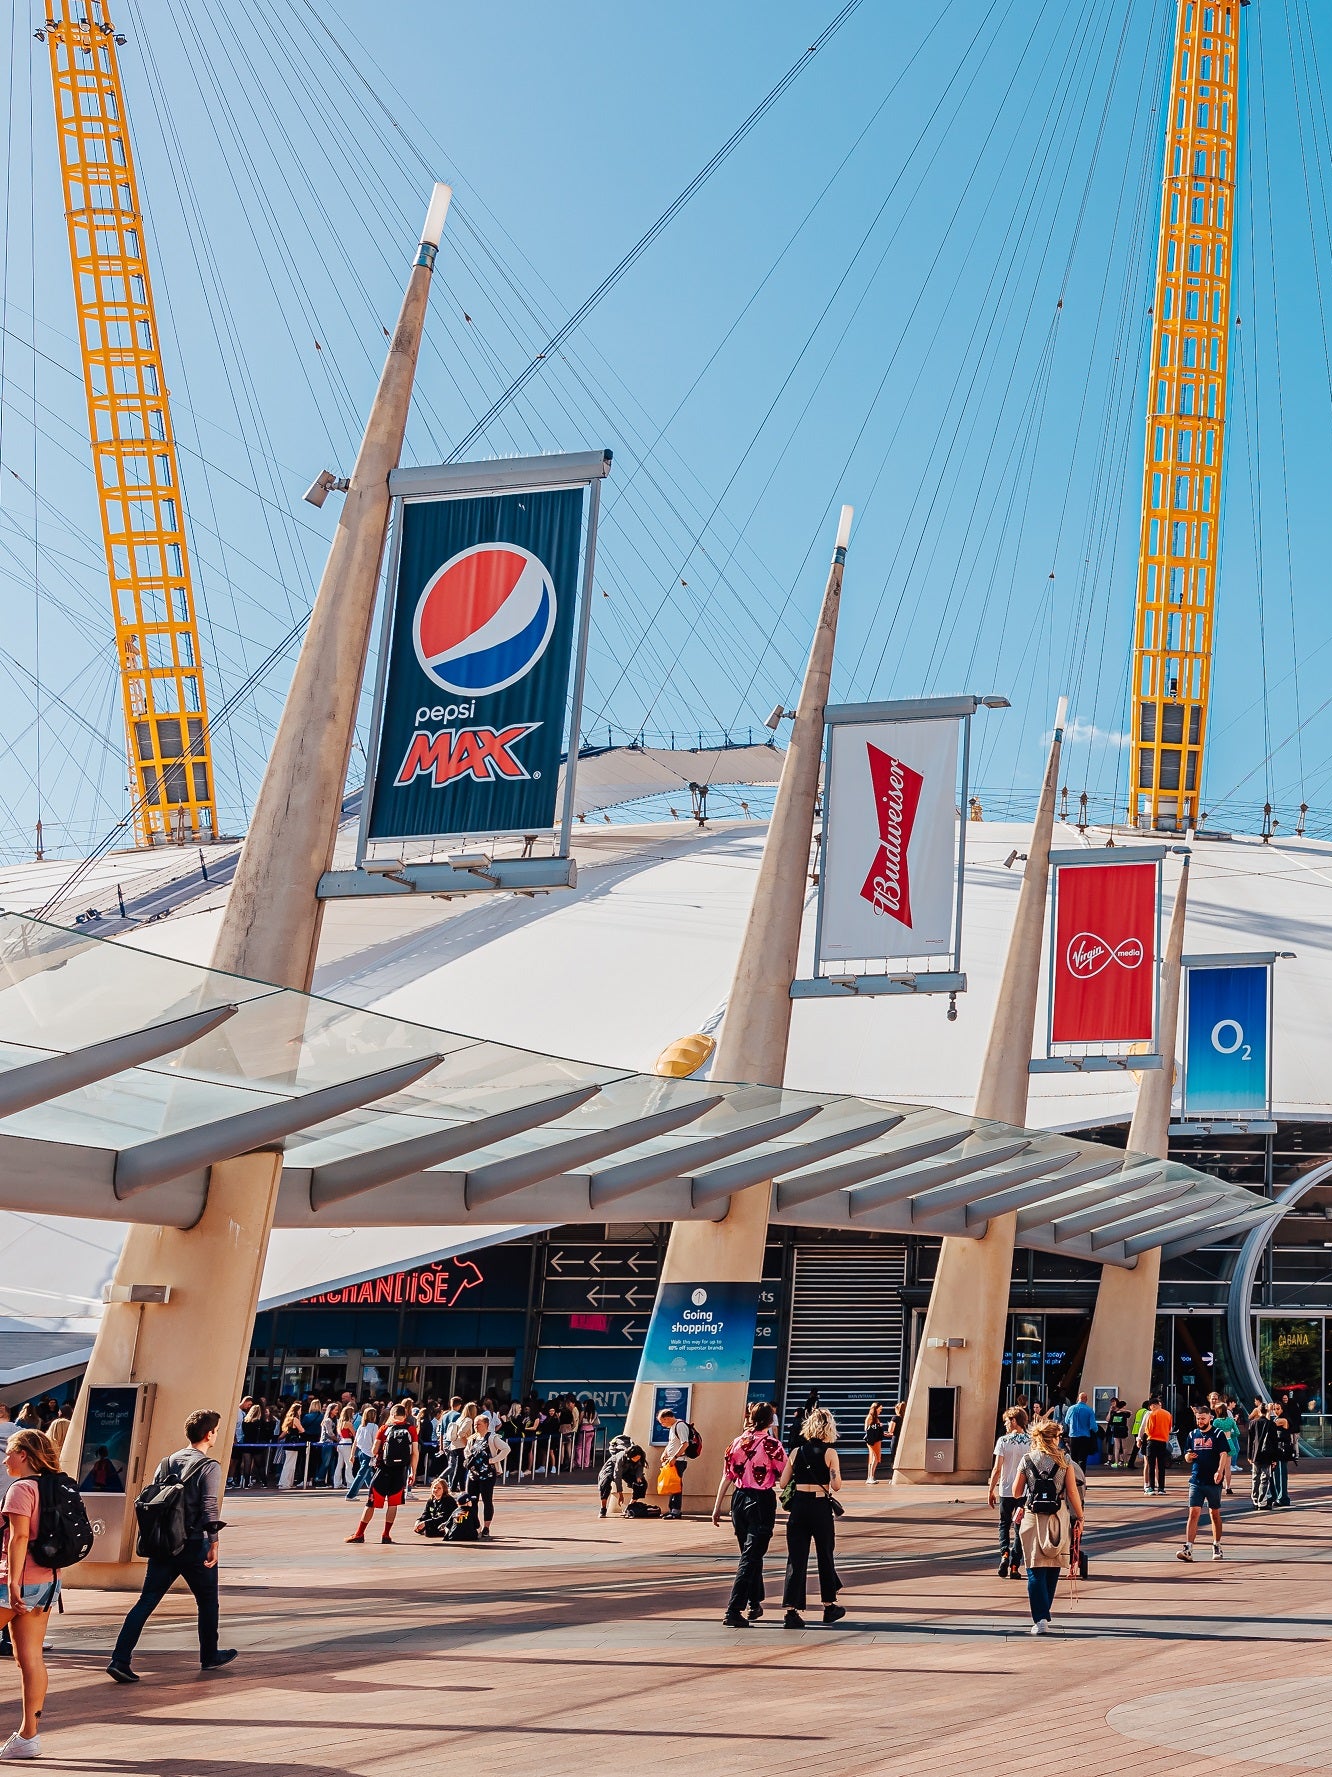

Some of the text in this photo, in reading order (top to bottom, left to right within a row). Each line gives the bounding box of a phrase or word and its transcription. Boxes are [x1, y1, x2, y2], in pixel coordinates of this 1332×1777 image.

[415, 700, 475, 726] pepsi
[393, 722, 544, 788] MAX
[873, 758, 905, 916] Budweiser
[1072, 940, 1105, 970] Virgin
[1117, 949, 1140, 957] media
[1211, 1019, 1252, 1061] O2
[683, 1310, 713, 1323] Going
[671, 1322, 724, 1335] shopping?
[1278, 1334, 1309, 1347] CABANA
[548, 1391, 632, 1407] PORITY
